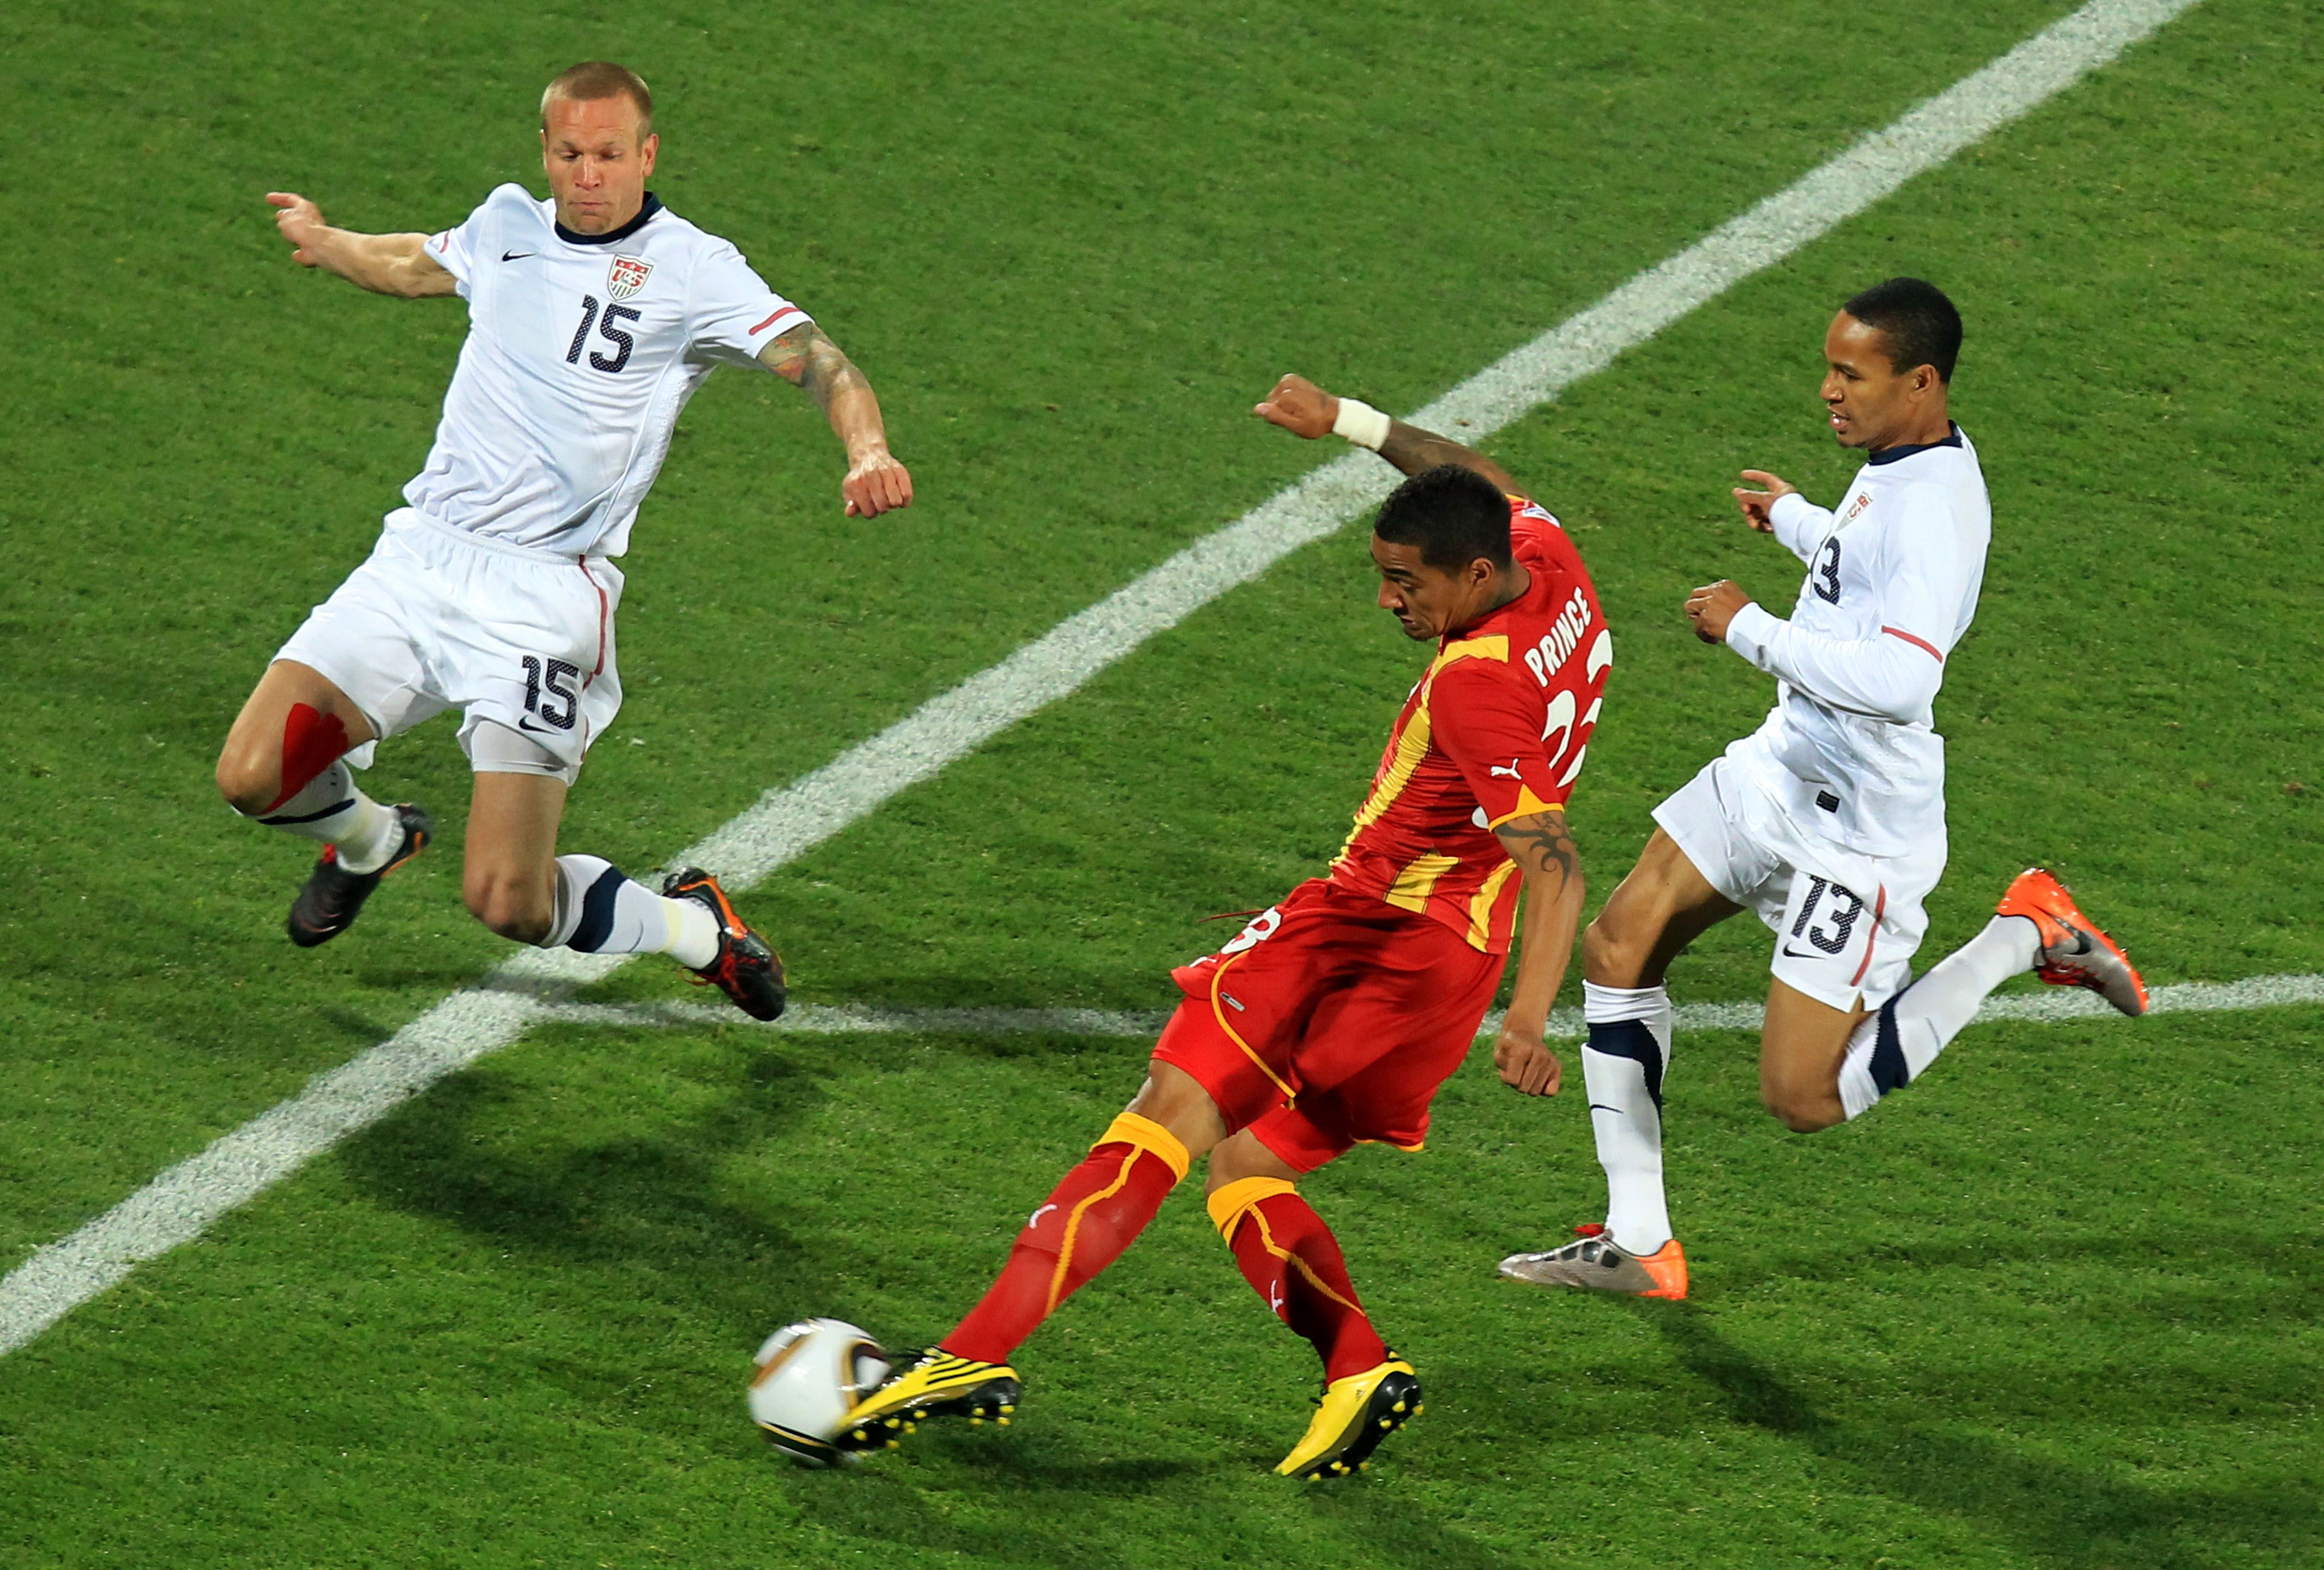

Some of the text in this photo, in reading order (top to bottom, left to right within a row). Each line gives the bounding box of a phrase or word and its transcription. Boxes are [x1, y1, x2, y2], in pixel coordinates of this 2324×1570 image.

[566, 294, 642, 373] 15
[1809, 529, 1841, 606] 3
[1524, 585, 1591, 687] PRINCE
[522, 655, 580, 730] 15
[1791, 874, 1863, 955] 13
